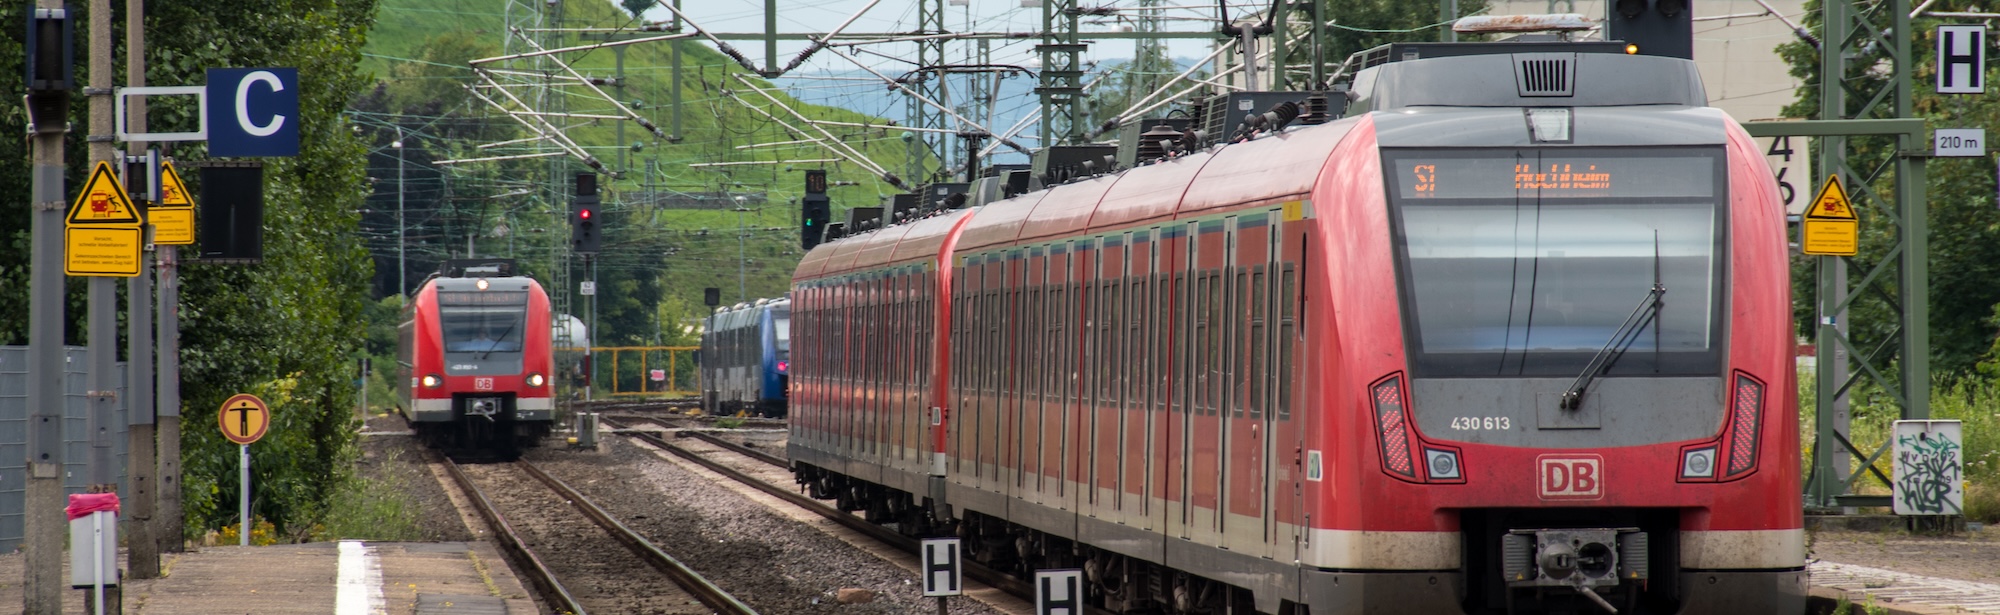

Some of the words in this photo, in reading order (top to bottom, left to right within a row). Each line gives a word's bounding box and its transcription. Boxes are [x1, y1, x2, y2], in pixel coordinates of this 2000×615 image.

[1943, 31, 1980, 88] H
[235, 71, 286, 137] C
[1767, 135, 1794, 162] 4
[1940, 136, 1961, 149] 210
[1964, 139, 1978, 149] m
[1414, 164, 1436, 192] S1
[1515, 164, 1610, 189] Hochheim
[1777, 167, 1795, 206] 6
[476, 379, 492, 389] DB
[1451, 416, 1480, 430] 430
[1483, 416, 1510, 430] 613
[1546, 462, 1596, 493] DB
[926, 543, 957, 592] H
[1041, 575, 1077, 615] H
